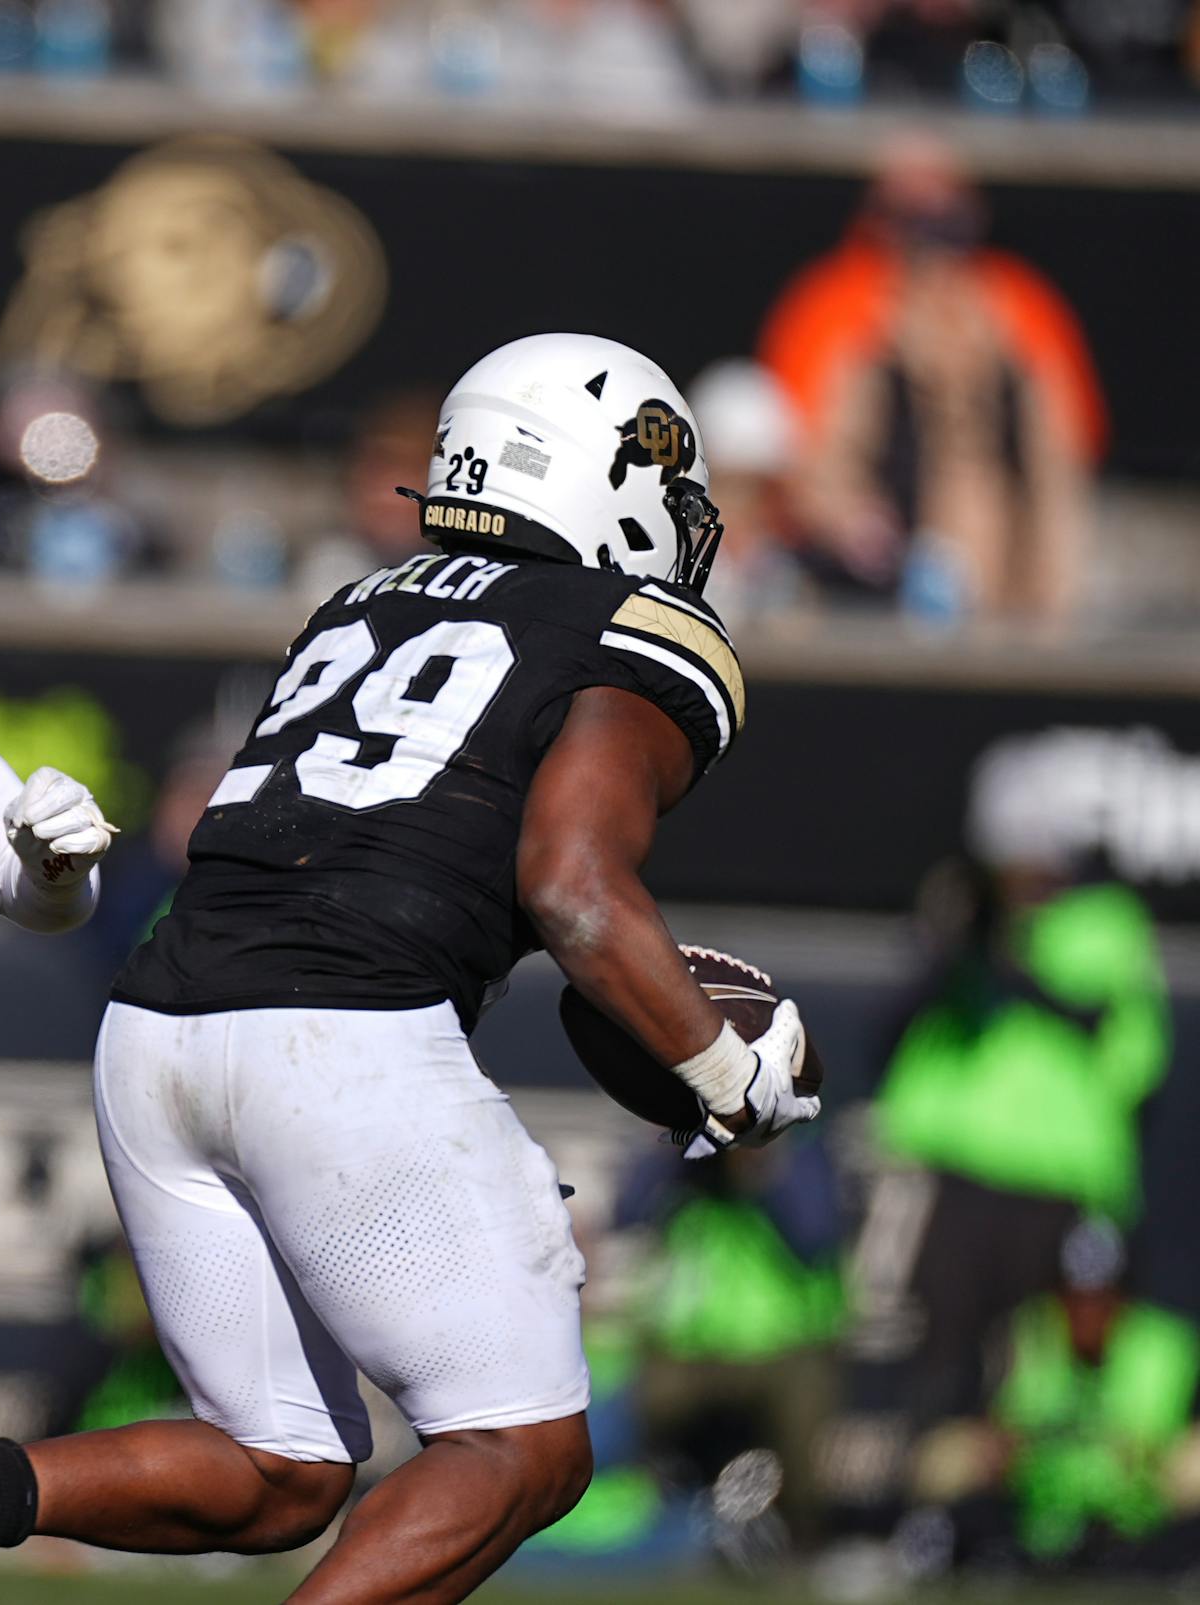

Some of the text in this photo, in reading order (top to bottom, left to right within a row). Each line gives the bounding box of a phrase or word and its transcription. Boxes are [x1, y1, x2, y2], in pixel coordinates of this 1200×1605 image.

[637, 407, 679, 466] CU
[446, 453, 488, 495] 29
[425, 505, 505, 536] COLORADO
[344, 554, 519, 605] WELCH
[206, 617, 518, 811] 29
